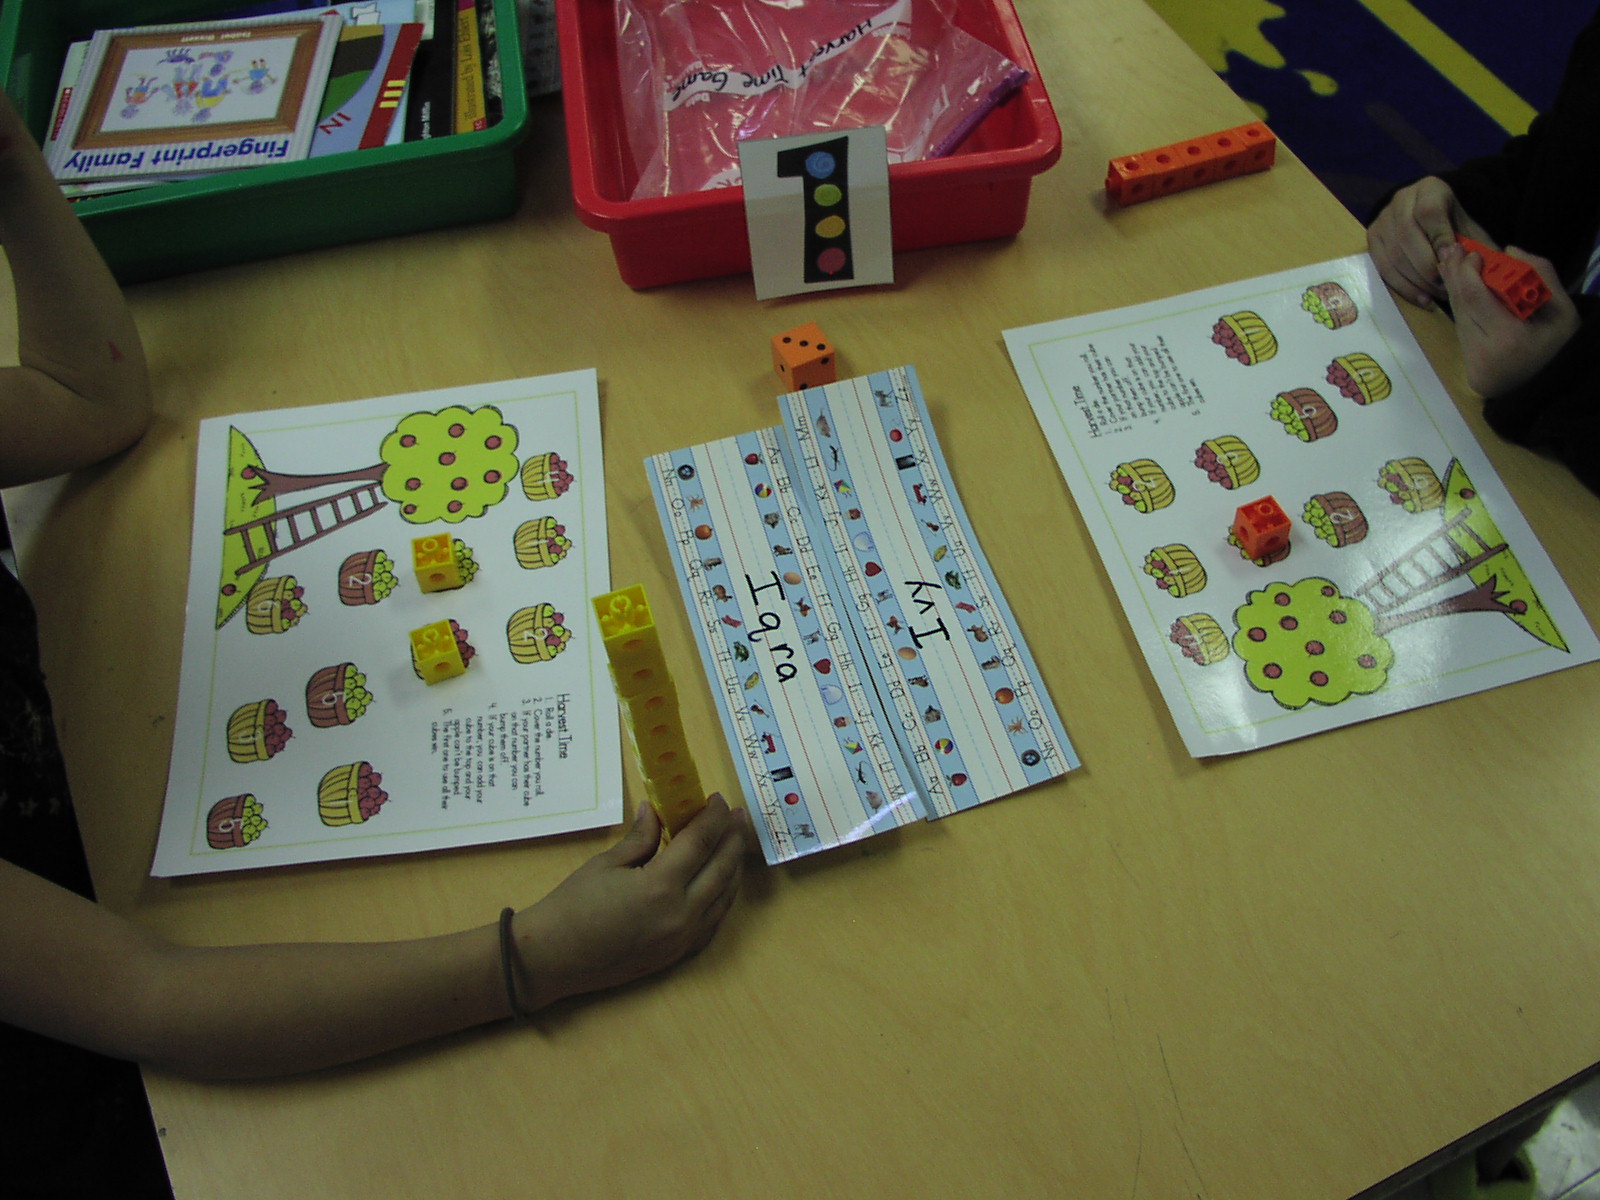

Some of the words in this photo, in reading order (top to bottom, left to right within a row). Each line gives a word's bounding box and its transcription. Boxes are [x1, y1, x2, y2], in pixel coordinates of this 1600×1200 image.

[801, 19, 871, 80] Harvet
[740, 64, 788, 90] Time
[63, 148, 145, 172] Family
[151, 138, 289, 167] Fingerprint
[777, 136, 854, 283] 1
[1072, 385, 1087, 405] Time
[1297, 405, 1318, 420] 5
[1081, 406, 1102, 438] Harvest
[1132, 478, 1158, 493] 2
[1330, 509, 1354, 524] 2
[347, 573, 372, 587] 2
[903, 579, 951, 650] Ivy
[522, 626, 548, 642] 2
[745, 570, 798, 684] Iqra
[320, 690, 345, 705] 5
[533, 708, 542, 730] Cover
[545, 707, 554, 720] Roll
[557, 694, 570, 732] Harvest
[443, 721, 451, 732] The
[465, 718, 473, 734] cube
[486, 723, 495, 737] your
[497, 712, 508, 732] bump
[521, 718, 529, 732] your
[431, 722, 439, 741] cubes
[534, 732, 542, 743] the
[443, 735, 452, 748] first
[454, 740, 462, 756] can't
[520, 735, 530, 759] partner
[558, 735, 572, 759] Time
[464, 758, 472, 769] top
[535, 745, 544, 770] number
[452, 768, 462, 795] bumped
[465, 771, 473, 784] and
[476, 774, 484, 788] add
[533, 772, 542, 784] you
[442, 795, 450, 810] their
[475, 790, 483, 804] your
[217, 817, 242, 832] 5
